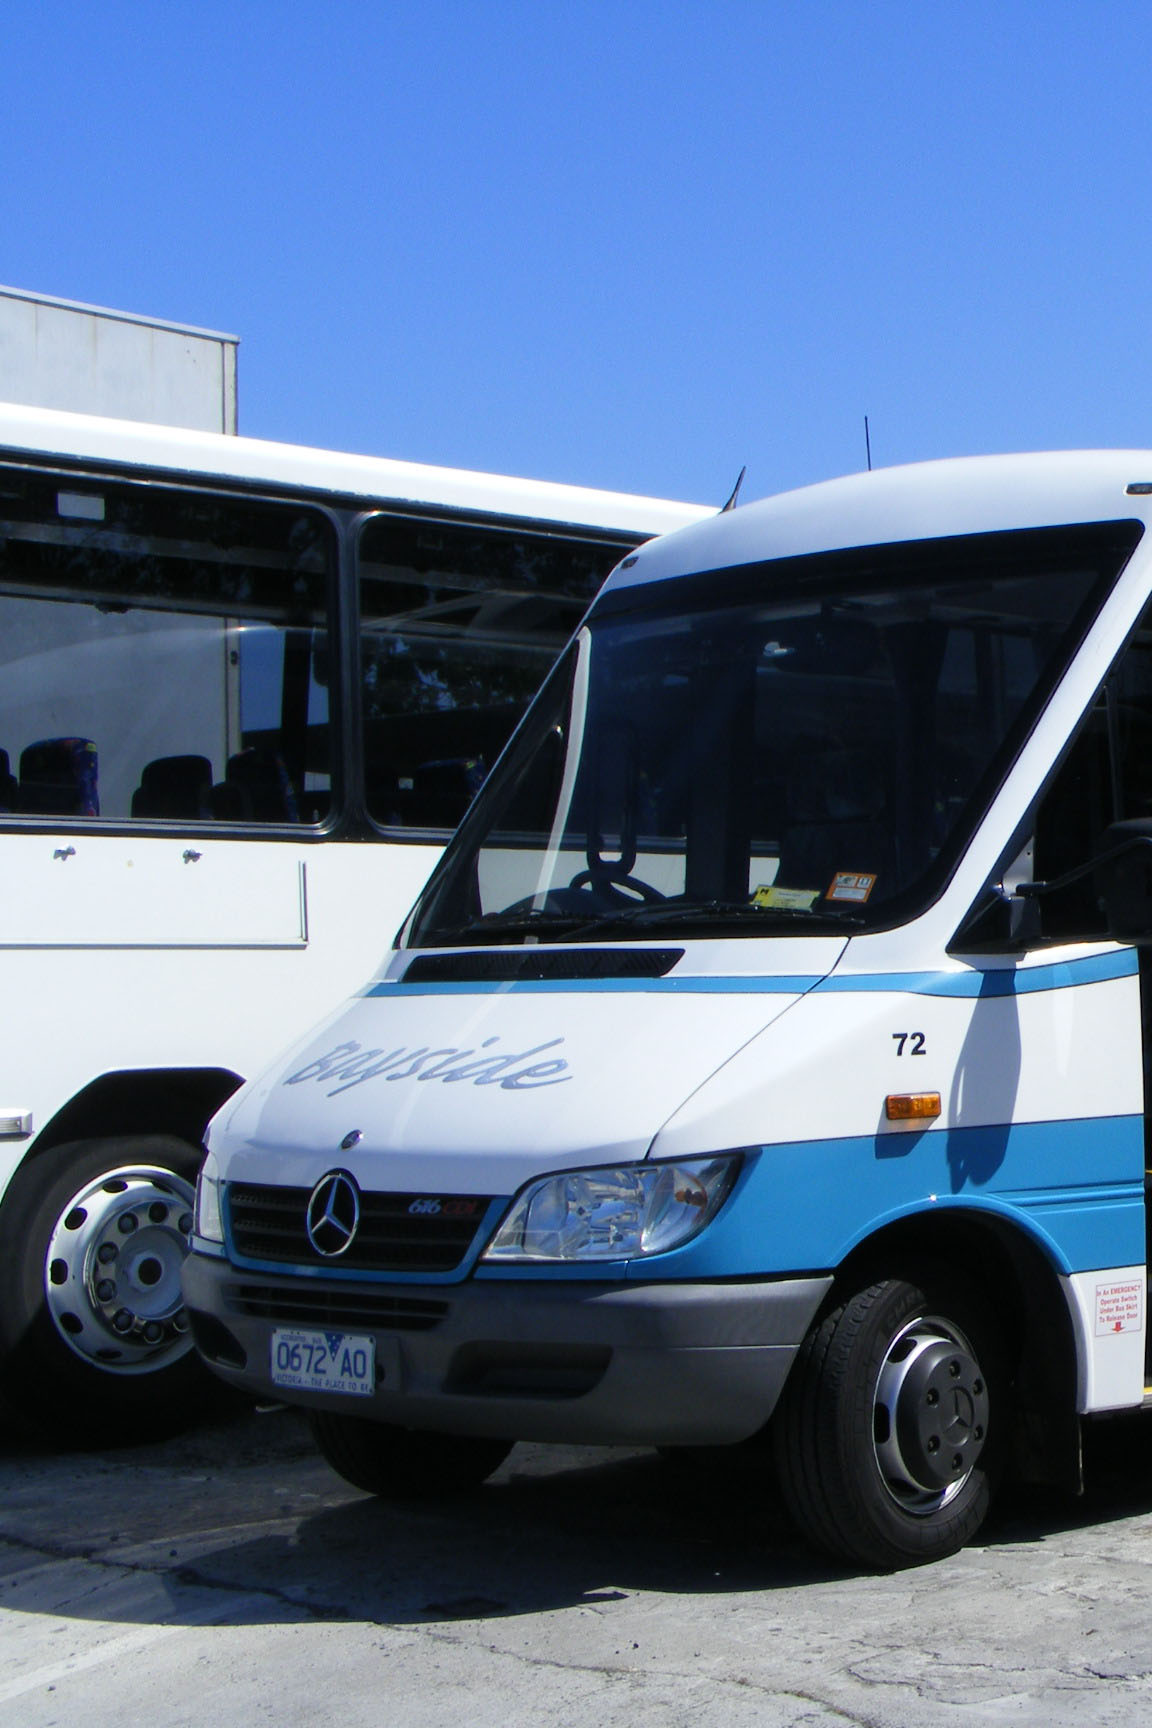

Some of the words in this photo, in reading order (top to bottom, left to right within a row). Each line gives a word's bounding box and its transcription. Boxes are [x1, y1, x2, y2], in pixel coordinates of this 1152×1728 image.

[892, 1032, 926, 1056] 72
[283, 1037, 573, 1098] Bayside
[1111, 1285, 1140, 1294] EMERGENCY
[1100, 1298, 1120, 1306] Operate
[277, 1341, 327, 1375] 0672
